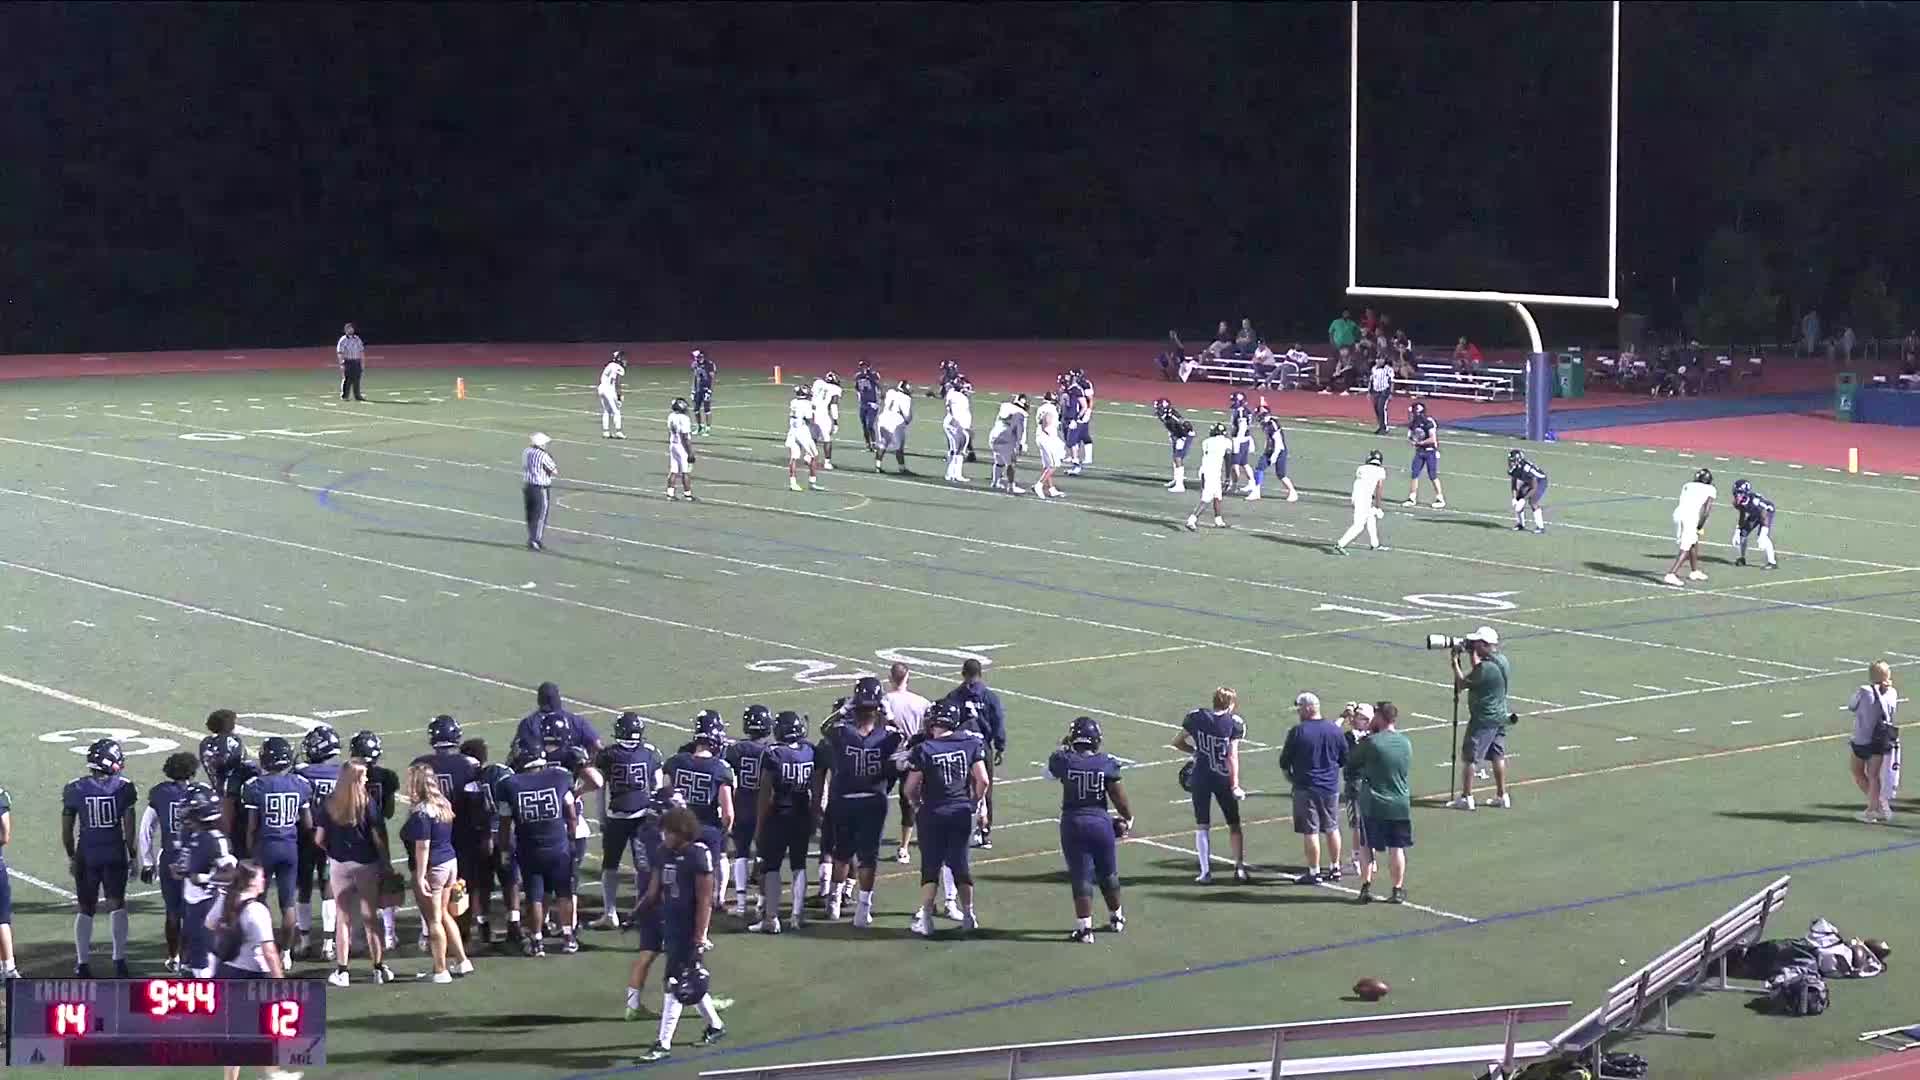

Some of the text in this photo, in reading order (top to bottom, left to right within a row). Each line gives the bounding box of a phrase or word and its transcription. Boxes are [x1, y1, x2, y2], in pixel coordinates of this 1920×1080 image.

[931, 749, 968, 786] 77
[1197, 730, 1232, 777] 43
[610, 762, 648, 792] 23
[675, 769, 712, 806] 55
[1067, 769, 1105, 800] 74
[84, 796, 119, 828] 10
[264, 792, 300, 828] 90
[518, 787, 560, 823] 63
